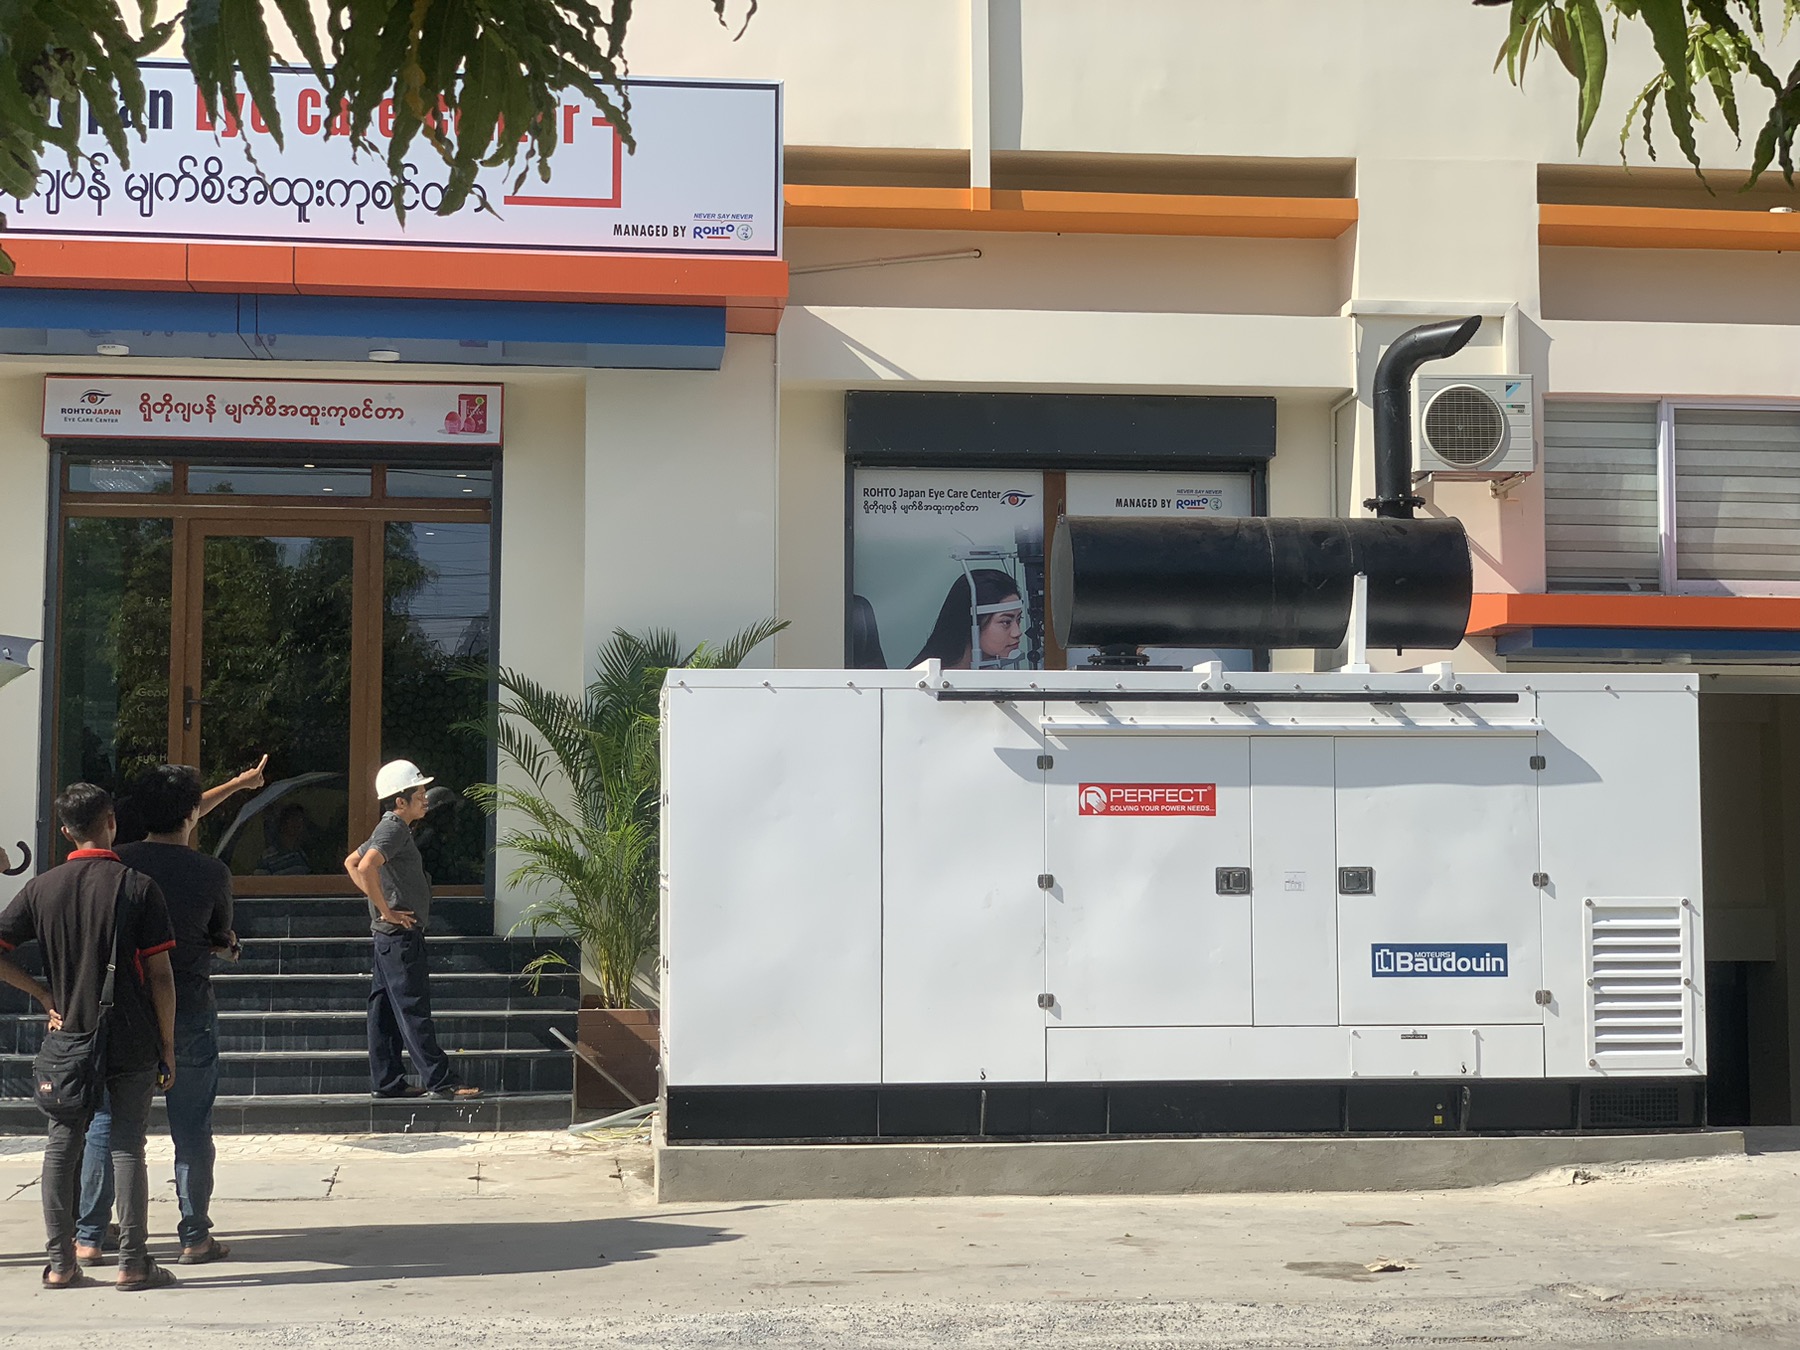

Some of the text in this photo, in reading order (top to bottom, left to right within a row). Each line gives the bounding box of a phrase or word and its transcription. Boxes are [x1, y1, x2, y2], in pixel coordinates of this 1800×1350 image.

[297, 88, 397, 138] Cae
[613, 223, 735, 239] MANAGED BY ROHTO
[863, 488, 1001, 500] ROHTO Japan Eye Care Center
[1115, 498, 1209, 510] MANAGED BY ROHTO
[1110, 788, 1207, 803] PERFECT
[1161, 804, 1186, 812] POWER
[1396, 951, 1504, 972] Baudouin
